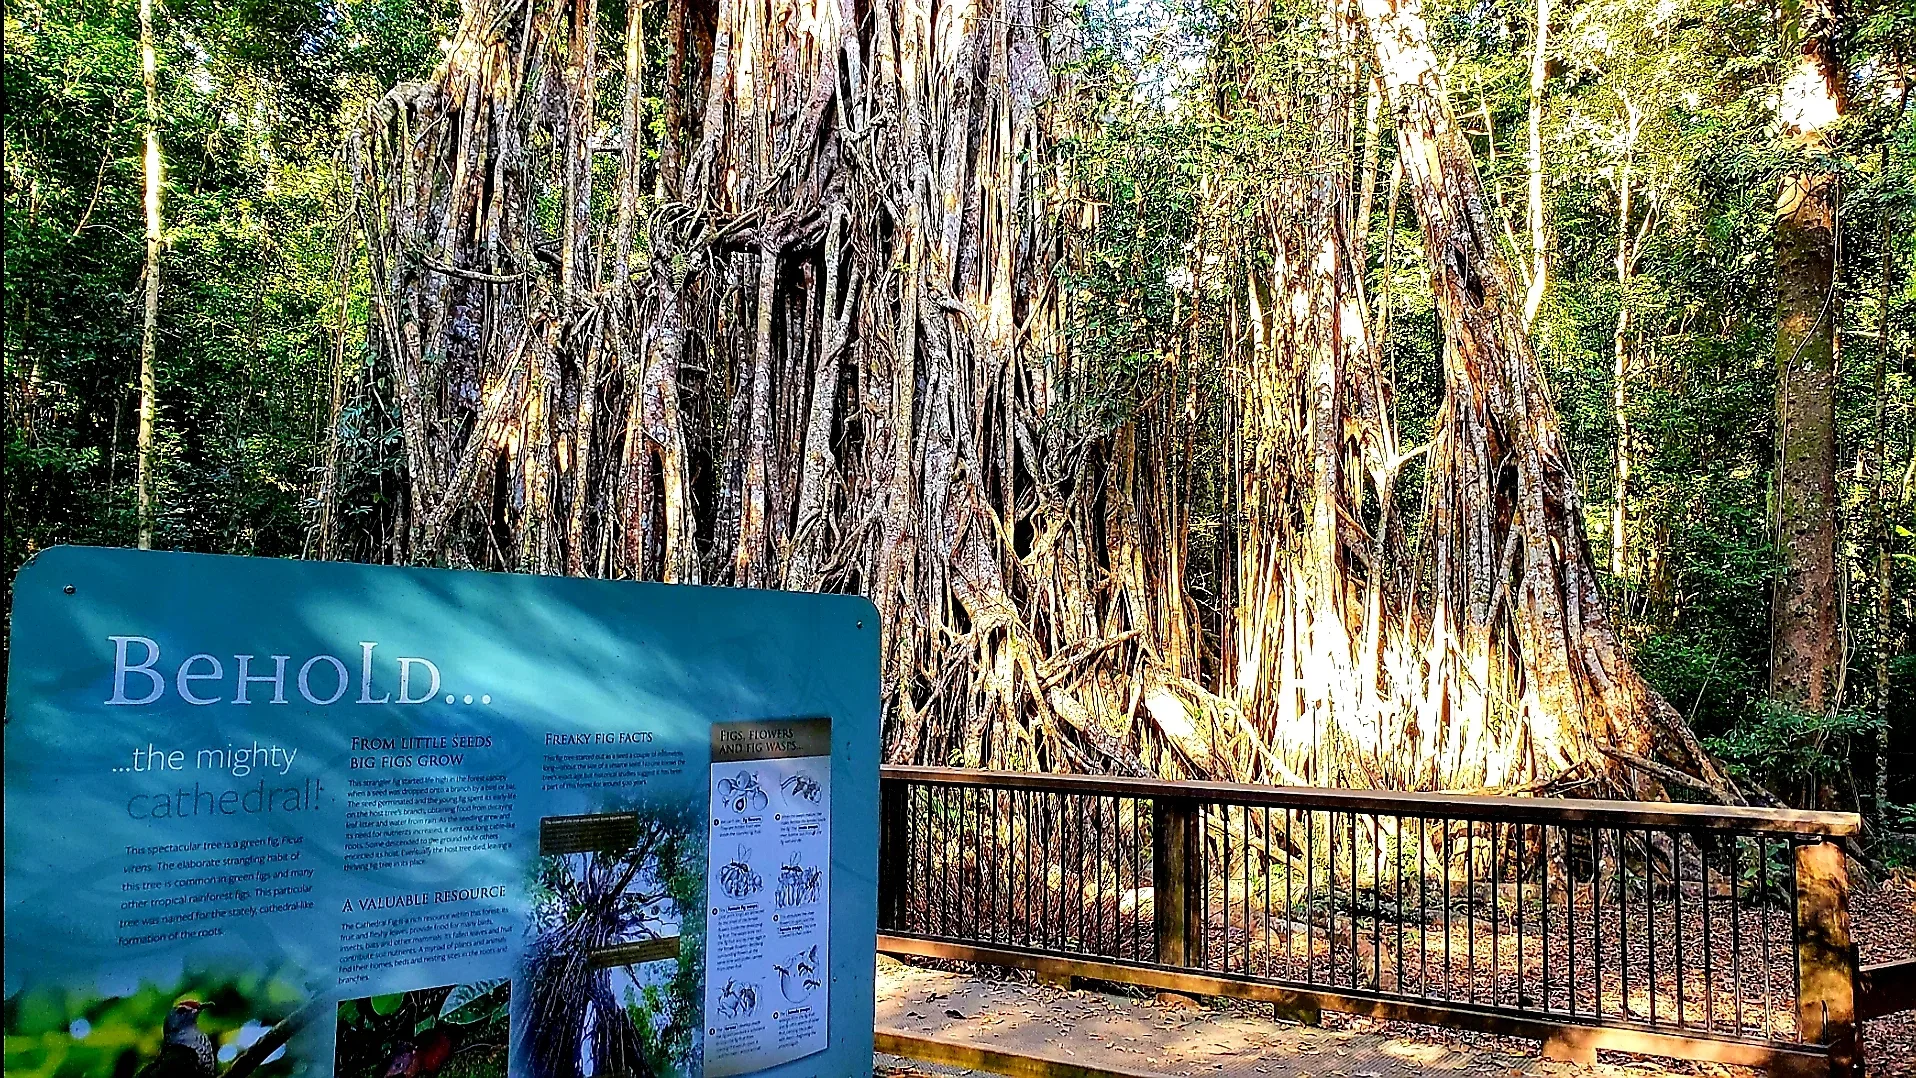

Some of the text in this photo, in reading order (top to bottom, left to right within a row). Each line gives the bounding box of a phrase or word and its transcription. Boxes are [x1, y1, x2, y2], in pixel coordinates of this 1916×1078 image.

[351, 735, 492, 751] FROM LITTLE SEEDS
[545, 732, 653, 745] FREAKY FIG FACTS
[721, 728, 794, 742] FIGS, FLOWERS
[720, 743, 743, 755] AND
[746, 742, 763, 753] FIG
[112, 741, 297, 777] ...the mighty
[350, 754, 464, 769] BIG FIGS GROW
[127, 778, 319, 820] cathedral!
[125, 845, 145, 855] This
[147, 842, 201, 855] spectacular
[203, 840, 222, 850] tree
[224, 840, 232, 849] is
[240, 840, 266, 849] green
[157, 861, 174, 871] The
[176, 858, 220, 869] elaborate
[222, 855, 266, 867] strangling
[267, 853, 289, 863] habit
[290, 851, 301, 861] of
[121, 869, 314, 891] this tree is common in green figs and many
[120, 898, 149, 909] other
[150, 895, 187, 908] tropical
[189, 891, 233, 903] rainforest
[255, 887, 272, 897] This
[273, 884, 313, 897] particular
[342, 885, 506, 913] A VALUABLE RESOURCE
[119, 918, 139, 928] tree
[141, 918, 160, 926] was
[160, 913, 194, 924] named
[195, 910, 211, 920] for
[211, 908, 227, 919] the
[228, 906, 258, 918] stately,
[118, 933, 165, 946] formation
[167, 931, 179, 941] of
[180, 929, 197, 939] the
